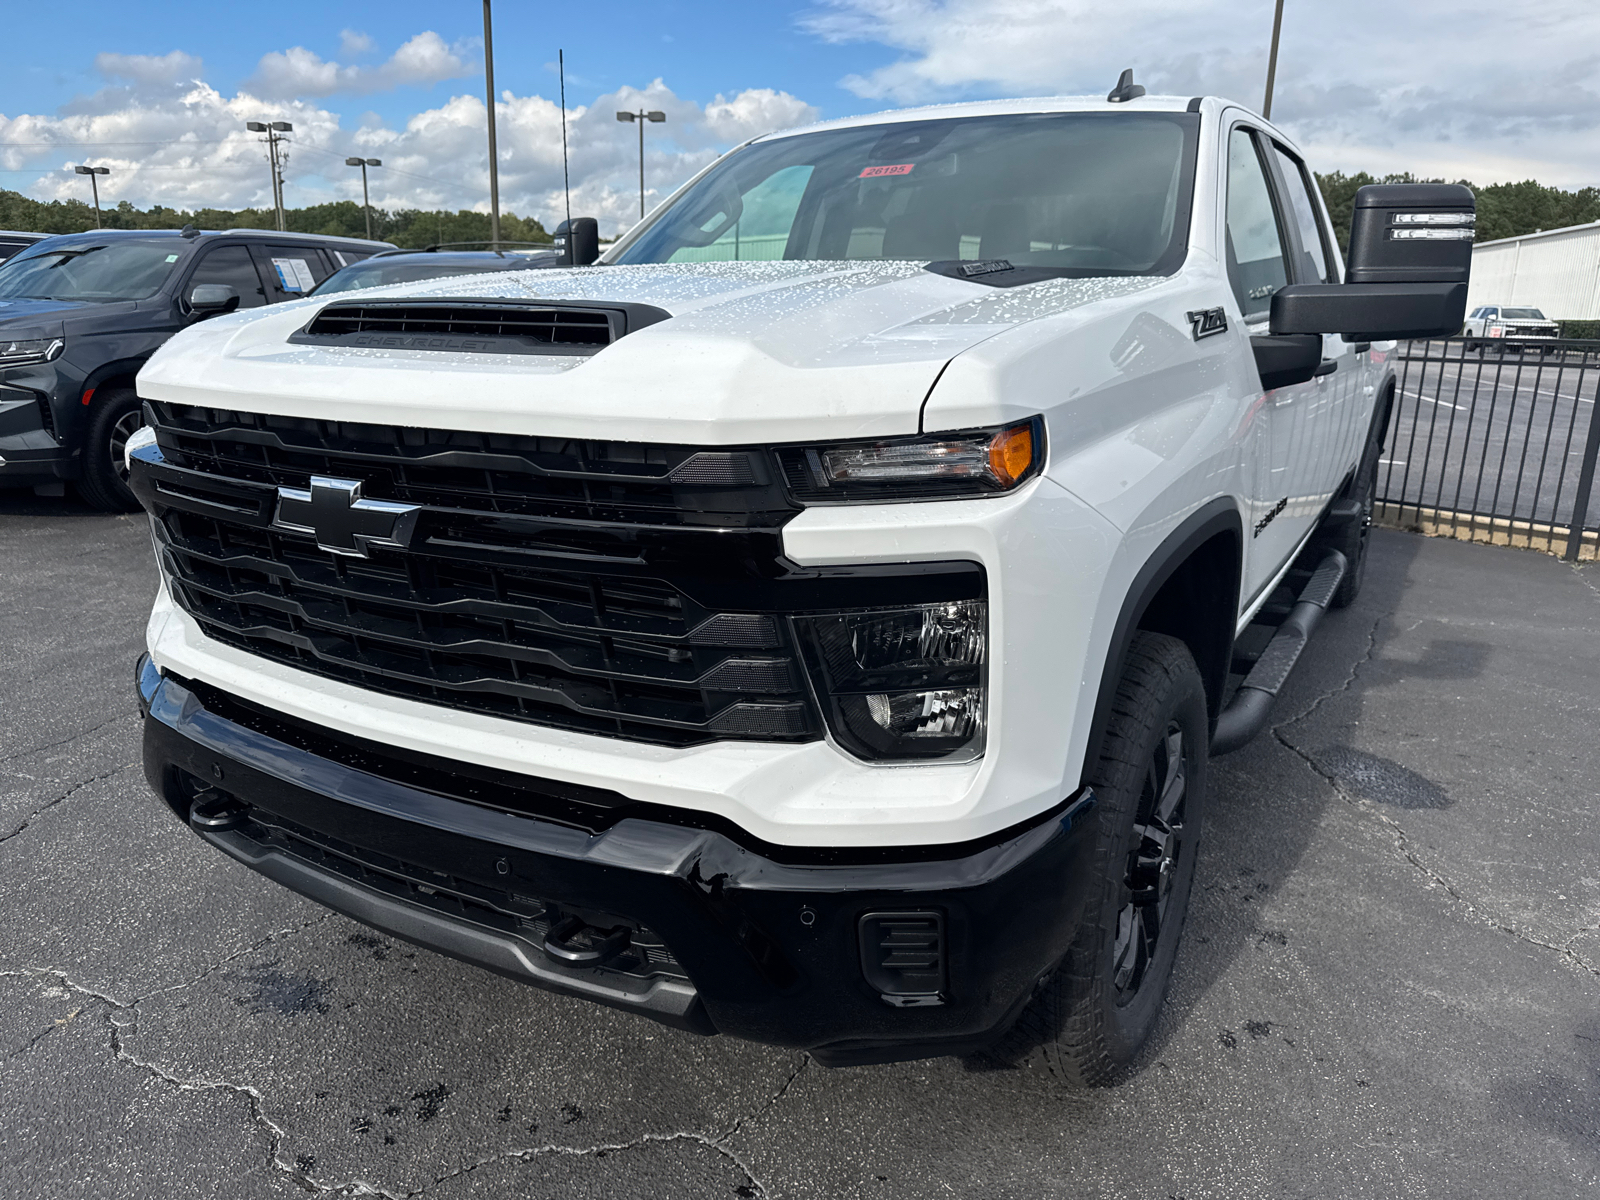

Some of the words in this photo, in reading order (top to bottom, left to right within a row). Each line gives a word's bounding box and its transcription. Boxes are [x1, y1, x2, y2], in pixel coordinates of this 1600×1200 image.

[866, 165, 906, 176] 26195
[1186, 306, 1228, 342] Z71
[354, 335, 496, 350] CHEVROLET
